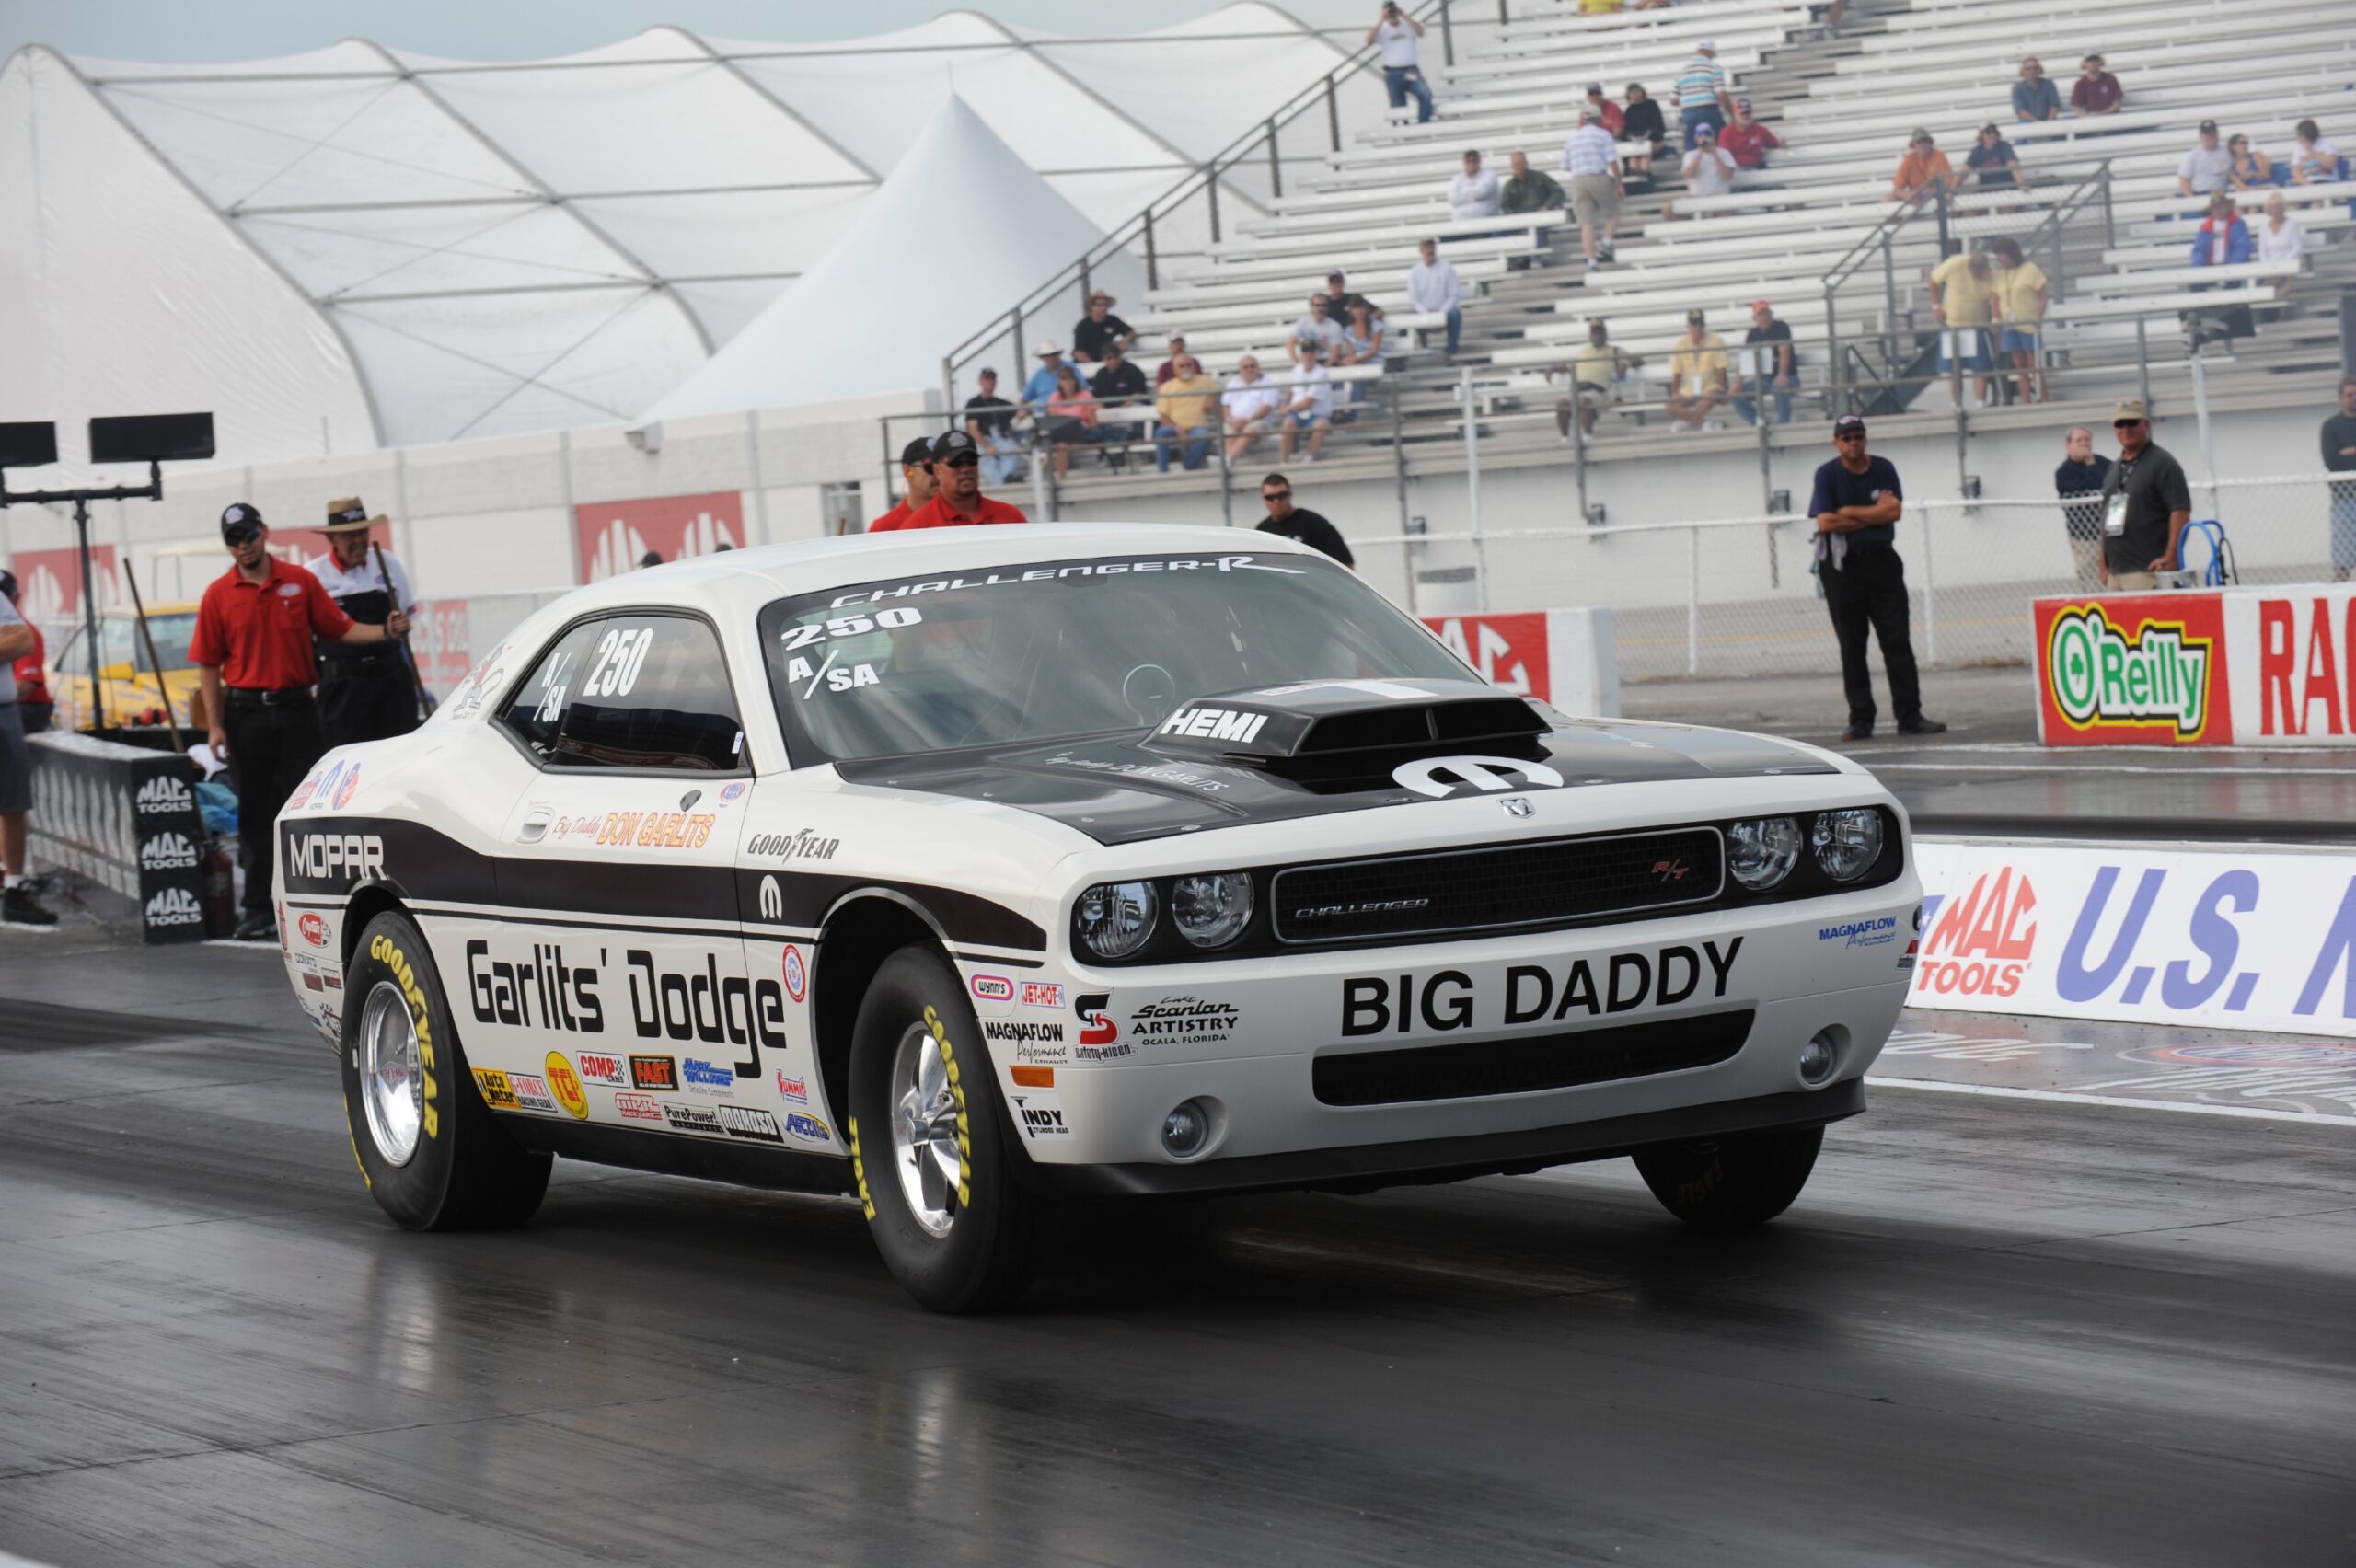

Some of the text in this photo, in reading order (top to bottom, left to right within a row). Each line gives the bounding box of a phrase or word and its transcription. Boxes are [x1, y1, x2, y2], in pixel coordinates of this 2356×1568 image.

[780, 606, 922, 651] 250
[583, 628, 653, 697] 250
[2059, 622, 2200, 719] O'Reilly
[2259, 597, 2356, 735] RA
[1159, 708, 1269, 744] HEMI
[136, 776, 191, 803] MAC
[137, 801, 193, 813] TOOLS
[596, 812, 643, 846] DON
[637, 812, 716, 848] GARLITS
[141, 832, 197, 859] MAC
[290, 834, 387, 880] MOPAR
[747, 829, 839, 863] GOODYEAR
[142, 857, 198, 870] TOOLS
[1651, 859, 1690, 882] R/T
[146, 887, 201, 916] MAC
[1295, 898, 1429, 918] CHALLENGER
[1924, 866, 2037, 960] MAC
[146, 912, 202, 926] TOOLS
[1819, 916, 1897, 940] MAGNAFLOW
[2056, 866, 2260, 1010] U.S.
[1341, 936, 1744, 1037] BIG DADDY
[1918, 961, 2023, 997] TOOLS
[467, 940, 607, 1033] Garlits'
[627, 949, 787, 1078] Dodge
[1131, 1000, 1239, 1019] Scanlan
[985, 1022, 1063, 1042] MAGNAFLOW
[1132, 1017, 1238, 1035] ARTISTRY
[580, 1055, 615, 1077] COMP
[635, 1061, 670, 1083] FAST
[683, 1058, 711, 1072] MARK
[484, 1072, 505, 1088] Auto
[509, 1076, 547, 1097] G-FORCE
[606, 1075, 624, 1083] CAMS
[685, 1070, 733, 1086] WILLIAMS
[488, 1088, 514, 1103] Meter
[664, 1105, 720, 1124] PurePower!
[720, 1107, 778, 1136] MOROSO
[1021, 1109, 1063, 1125] INDY
